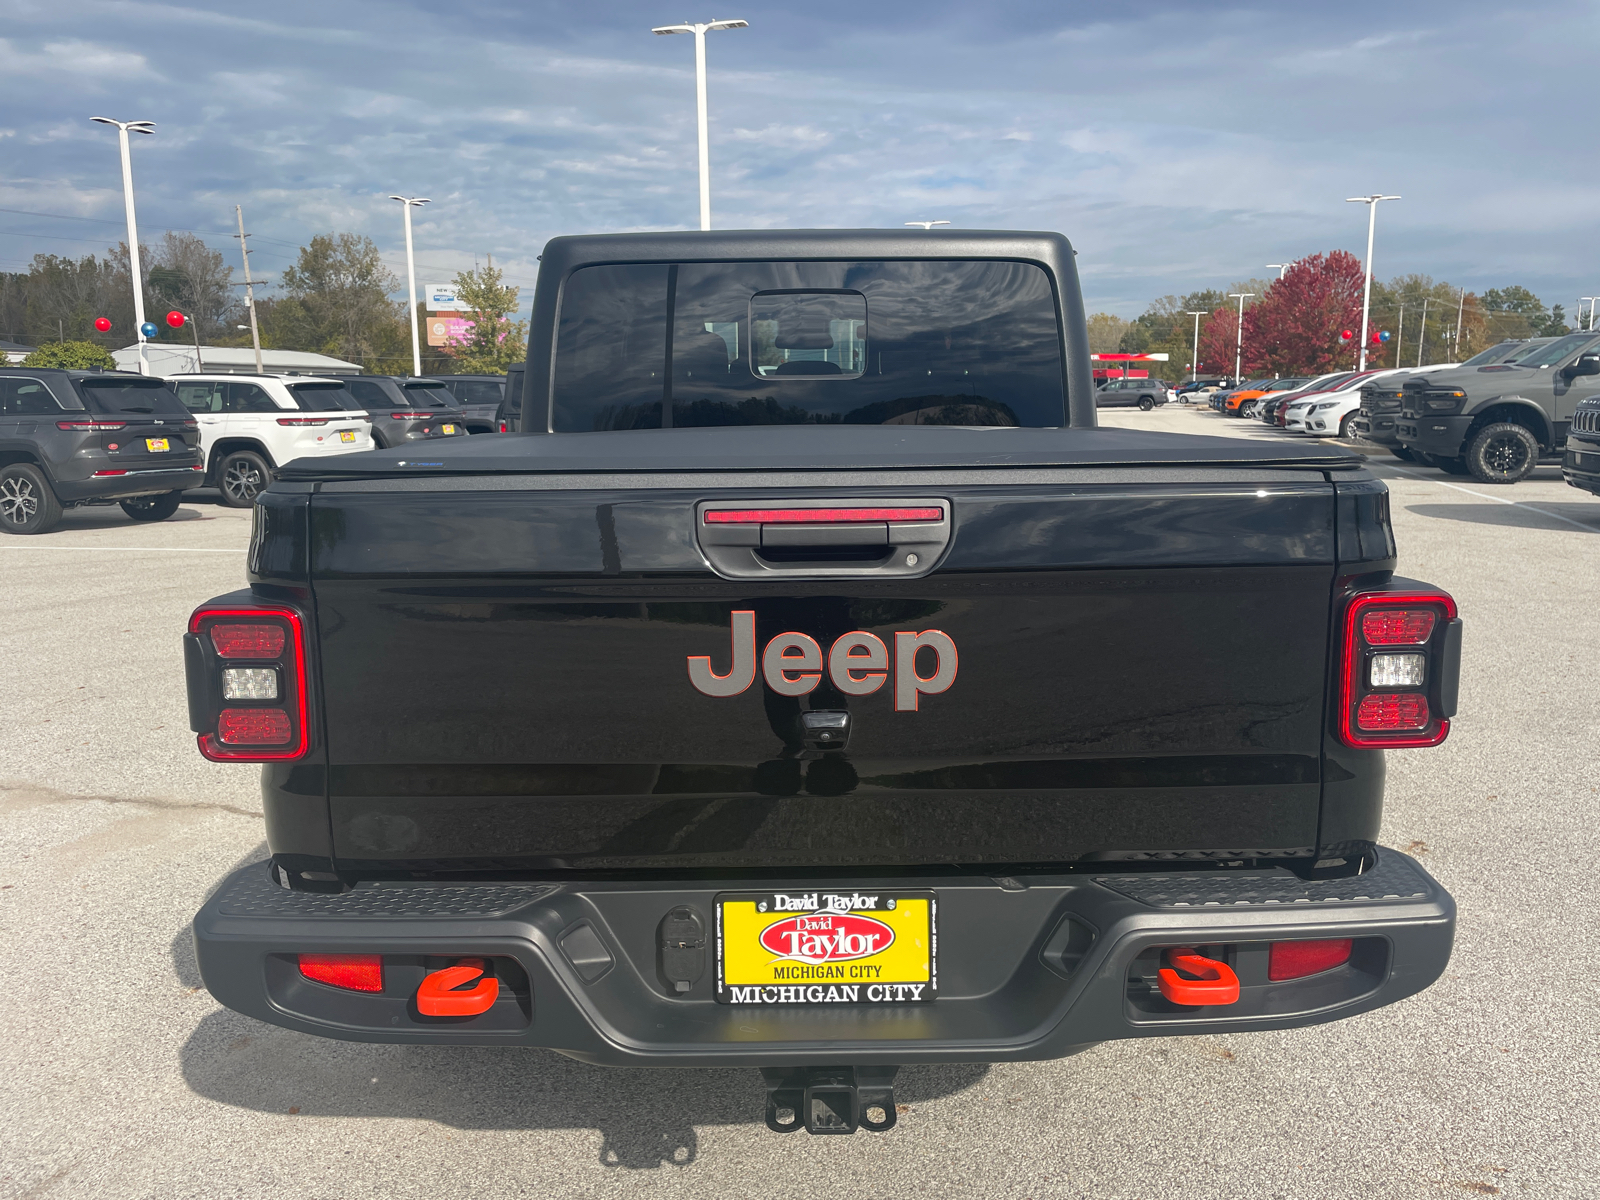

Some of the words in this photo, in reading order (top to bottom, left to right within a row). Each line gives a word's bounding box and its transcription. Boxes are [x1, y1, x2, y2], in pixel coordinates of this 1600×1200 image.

[687, 610, 959, 712] Jeep
[774, 893, 820, 911] David
[814, 893, 879, 915] Taylor
[795, 916, 833, 931] David
[780, 926, 880, 965] Taylor
[773, 965, 845, 980] MICHIGAN
[849, 964, 883, 978] CITY
[730, 985, 860, 1004] MICHIGAN
[866, 983, 926, 1002] CITY
